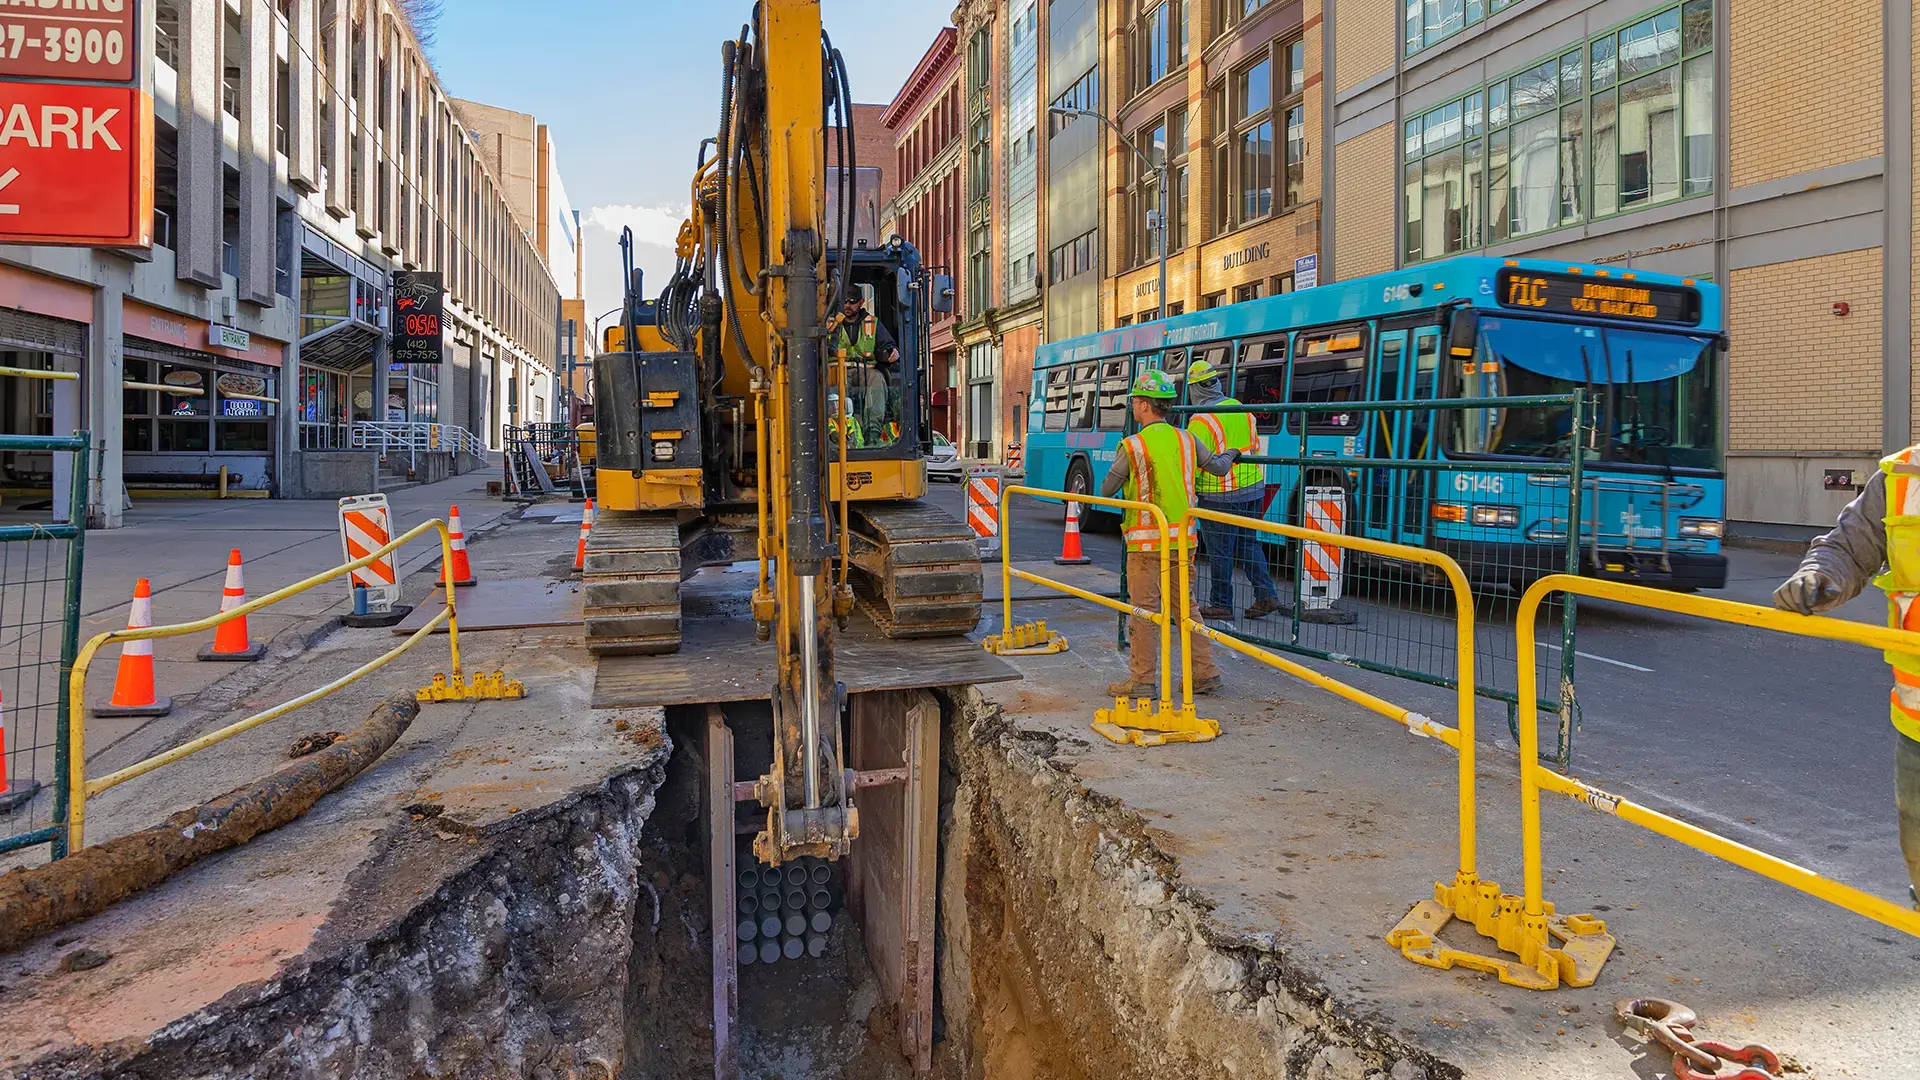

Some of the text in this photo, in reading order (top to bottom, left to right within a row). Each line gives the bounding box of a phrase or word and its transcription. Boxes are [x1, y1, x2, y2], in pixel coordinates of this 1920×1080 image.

[0, 103, 122, 151] ARK
[1223, 242, 1270, 271] BUILDING
[395, 287, 417, 299] PIZZA
[1383, 283, 1409, 302] 6146
[1509, 275, 1549, 307] 71C
[1571, 297, 1597, 312] VIA
[150, 315, 188, 341] ENTRANCE
[1167, 321, 1218, 345] PORT AUTHORITY
[222, 330, 247, 347] ENTRANCE
[407, 339, 427, 349] (412)
[396, 350, 438, 360] 575-7575
[230, 401, 254, 410] BUD
[1454, 473, 1504, 494] 6146
